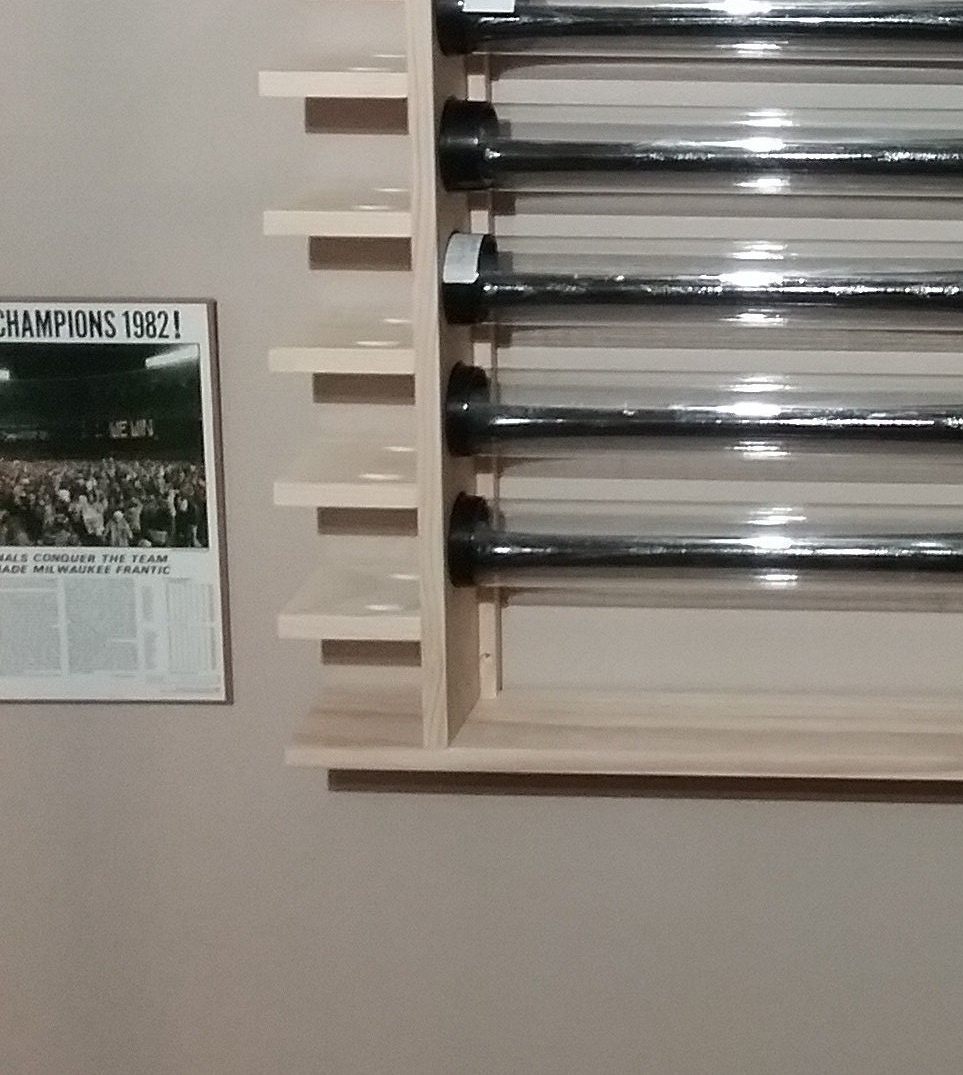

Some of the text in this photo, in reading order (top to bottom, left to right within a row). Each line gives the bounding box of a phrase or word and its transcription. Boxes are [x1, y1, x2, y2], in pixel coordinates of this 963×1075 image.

[33, 553, 96, 563] CONQUER
[102, 554, 126, 563] THE
[132, 555, 168, 563] TEAM
[0, 565, 171, 575] ADE MILWAUKEE FRANTIC
